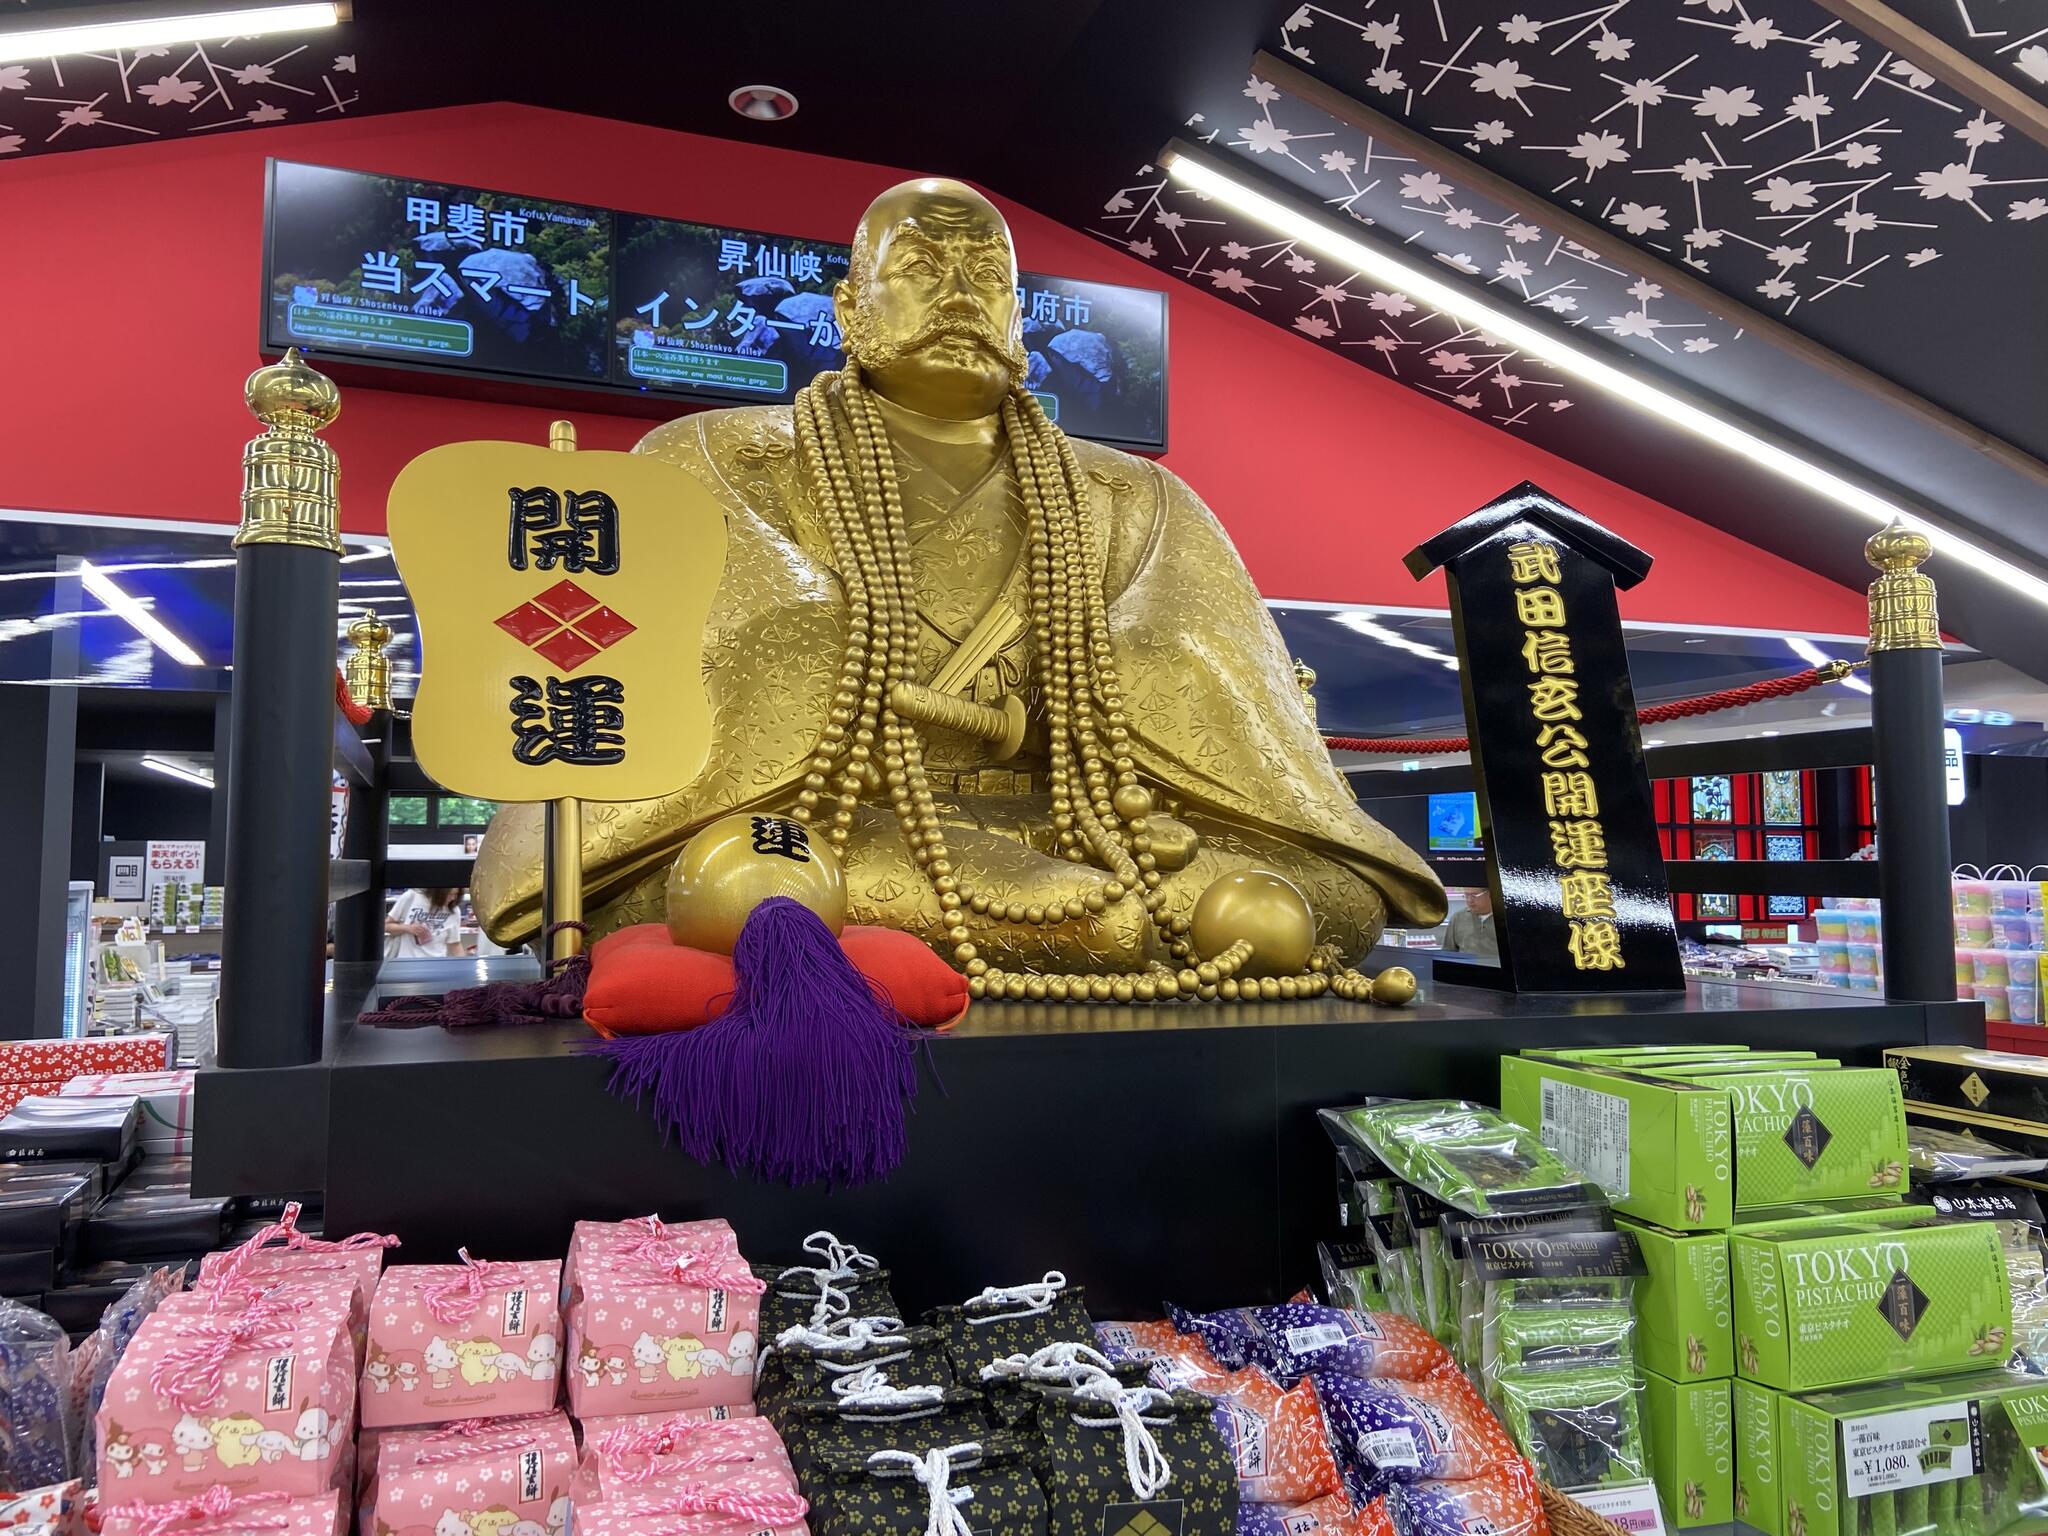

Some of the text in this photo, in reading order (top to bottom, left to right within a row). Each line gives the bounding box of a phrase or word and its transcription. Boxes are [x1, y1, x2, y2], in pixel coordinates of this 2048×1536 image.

[405, 196, 528, 247] 甲斐市
[360, 251, 595, 316] 当スマート
[717, 238, 823, 284] 昇仙峡
[508, 486, 626, 765] 開 運
[1507, 542, 1626, 972] 武田信玄公開運座像
[1704, 1097, 1714, 1162] PISTACHIO
[1726, 1083, 1815, 1115] OKYO
[1713, 1096, 1729, 1181] TOKYO
[1478, 1241, 1551, 1260] TOKYO
[1551, 1241, 1598, 1251] PISTACHIO
[1702, 1243, 1714, 1310] PISTACHIO
[1712, 1240, 1729, 1328] TOKYO
[1751, 1246, 1763, 1314] PISTACHIO
[1788, 1245, 1909, 1286] TOKYO
[1760, 1247, 1781, 1337] TOKYO
[1794, 1280, 1887, 1307] PISTACHIO
[1704, 1389, 1714, 1456] PISTACHIO
[1713, 1385, 1729, 1474] TOKYO
[1755, 1394, 1772, 1483] TOKYO
[1852, 1443, 1895, 1458] 東京ピスタチオ
[1814, 1419, 1832, 1511] TOKYO
